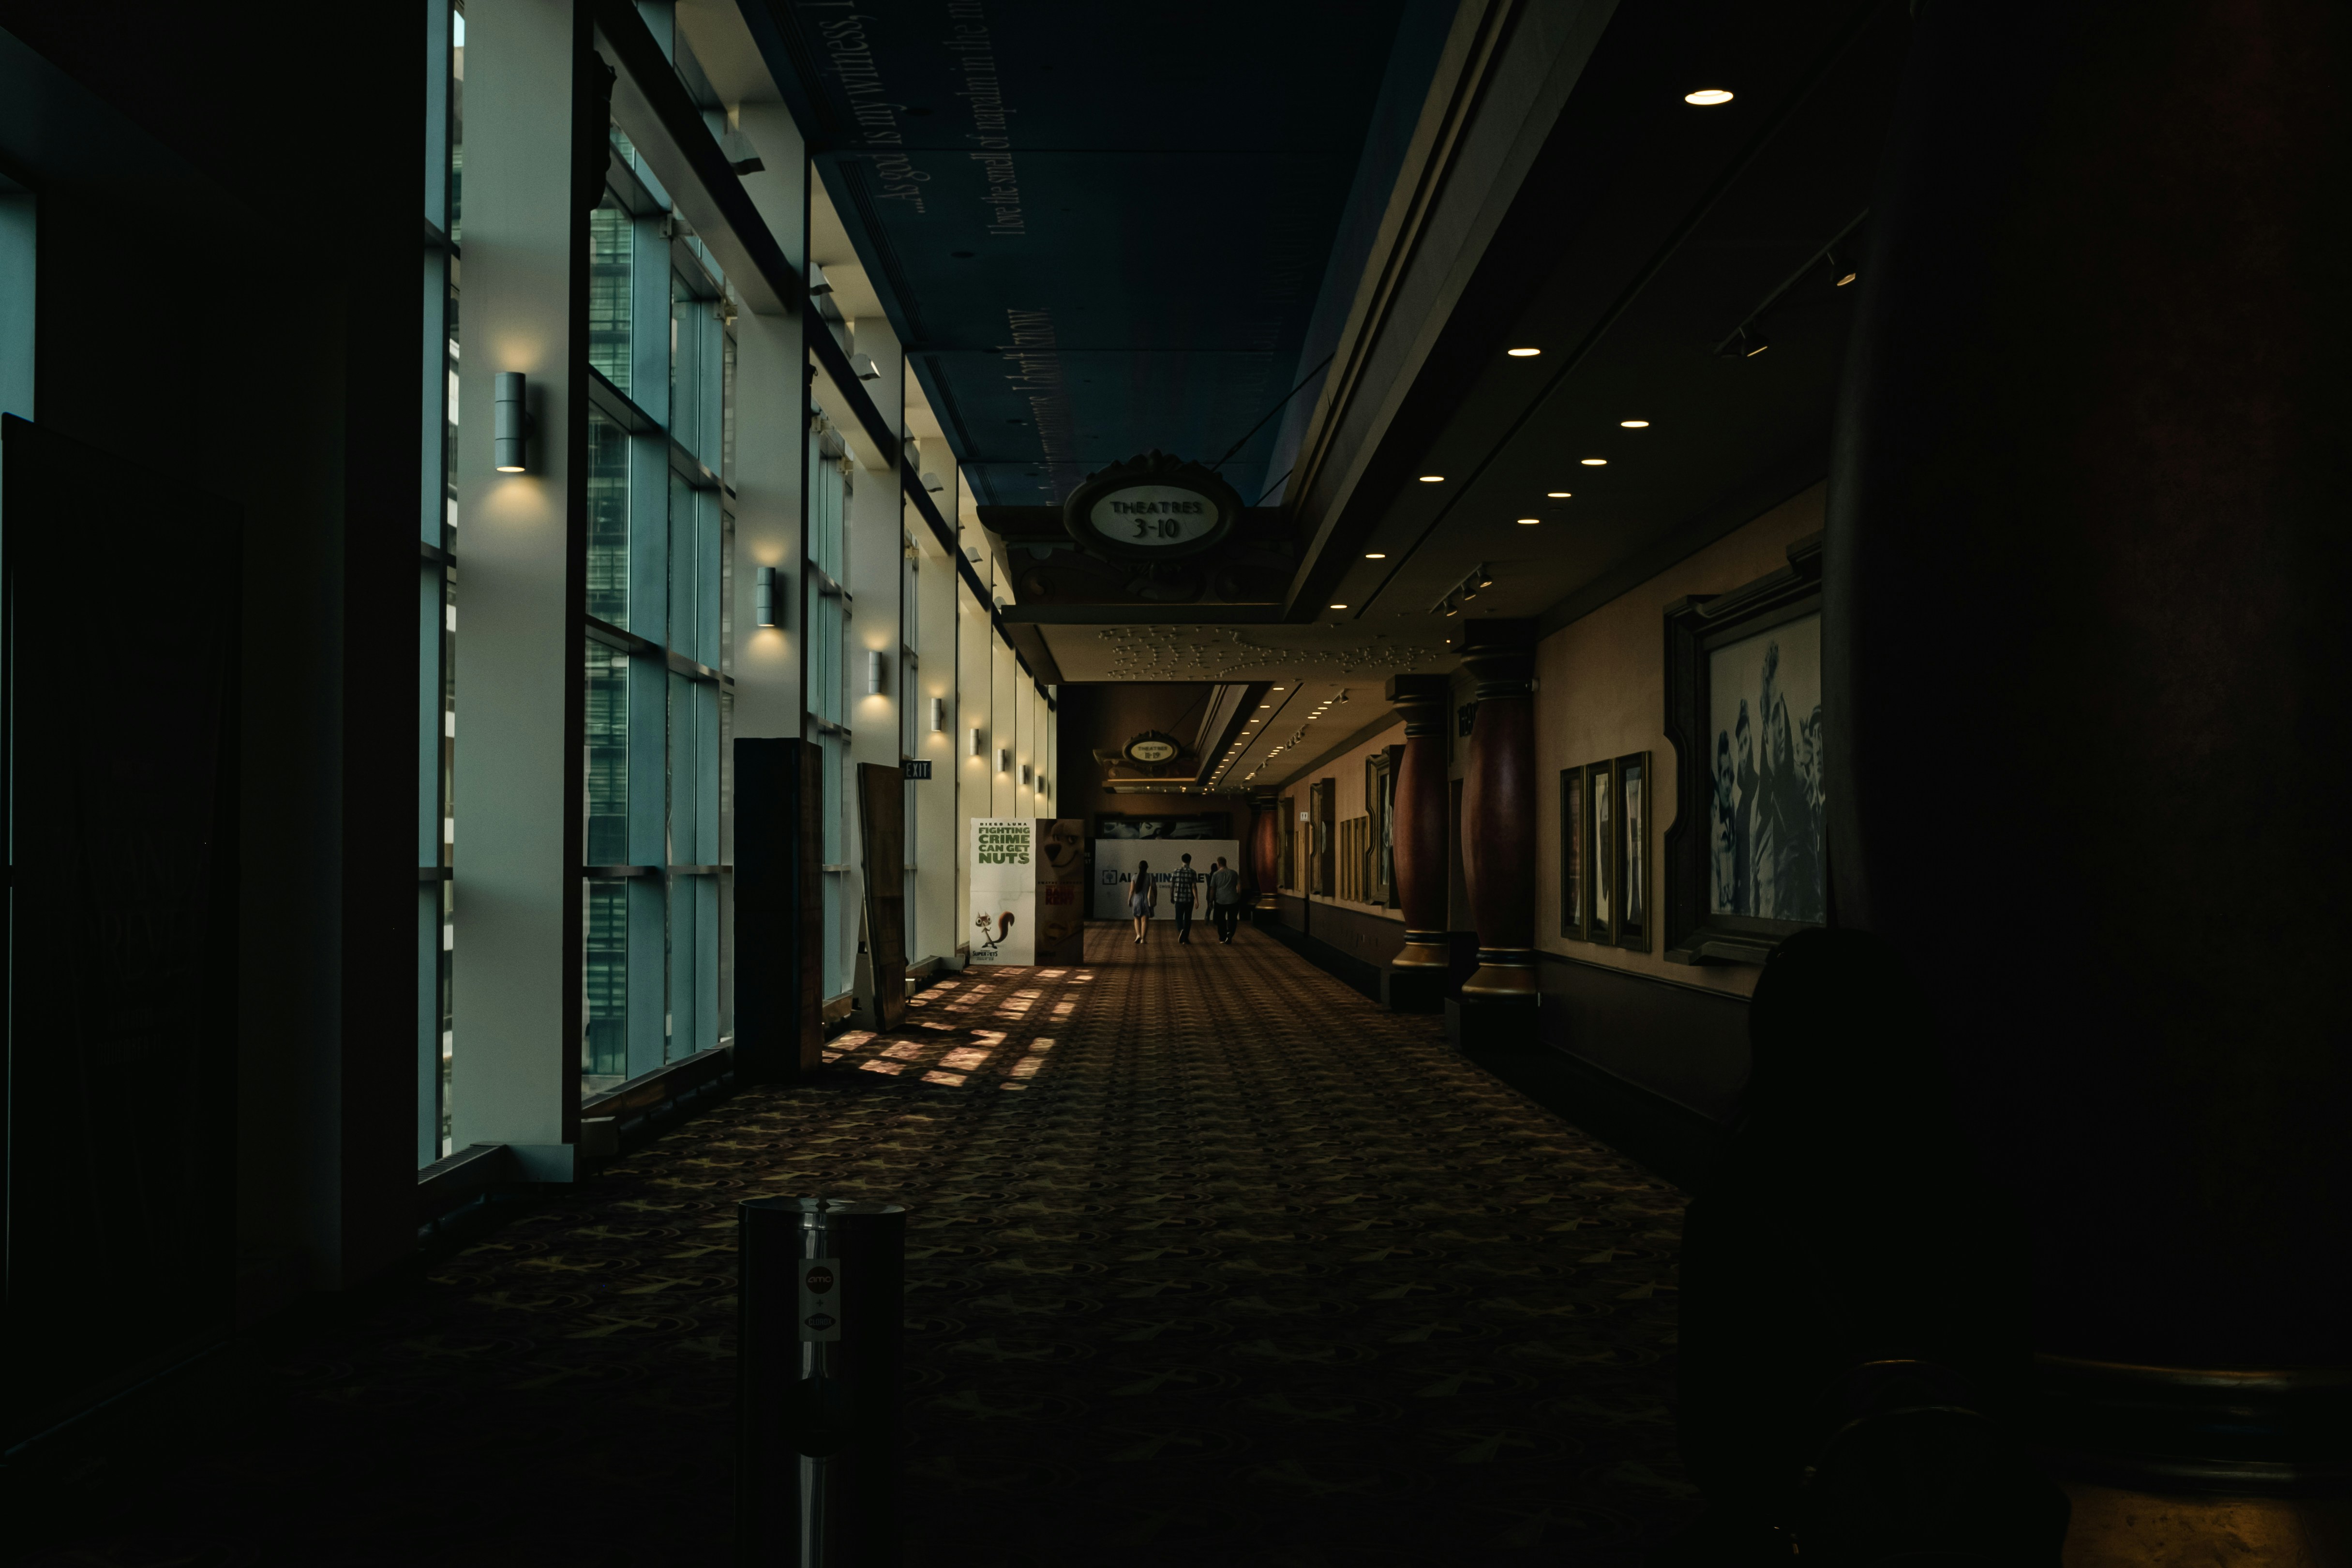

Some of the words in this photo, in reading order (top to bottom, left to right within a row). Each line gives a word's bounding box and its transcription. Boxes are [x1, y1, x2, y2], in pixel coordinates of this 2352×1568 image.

[942, 24, 992, 51] the
[819, 15, 886, 96] witness,
[949, 55, 996, 72] in
[851, 99, 908, 127] my
[954, 76, 1017, 131] napalm
[850, 131, 903, 145] is
[965, 134, 1011, 149] of
[856, 153, 931, 182] god
[969, 152, 1017, 184] smell
[980, 186, 1020, 204] the
[986, 206, 1025, 229] love
[995, 307, 1057, 350] know.
[1002, 352, 1061, 384] don't
[1110, 501, 1202, 514] THEATRES
[1132, 518, 1179, 538] 3-10
[906, 763, 928, 777] EXIT
[978, 835, 1030, 844] CRIME
[979, 852, 1030, 864] NUTS
[808, 1317, 832, 1326] CLOROX
